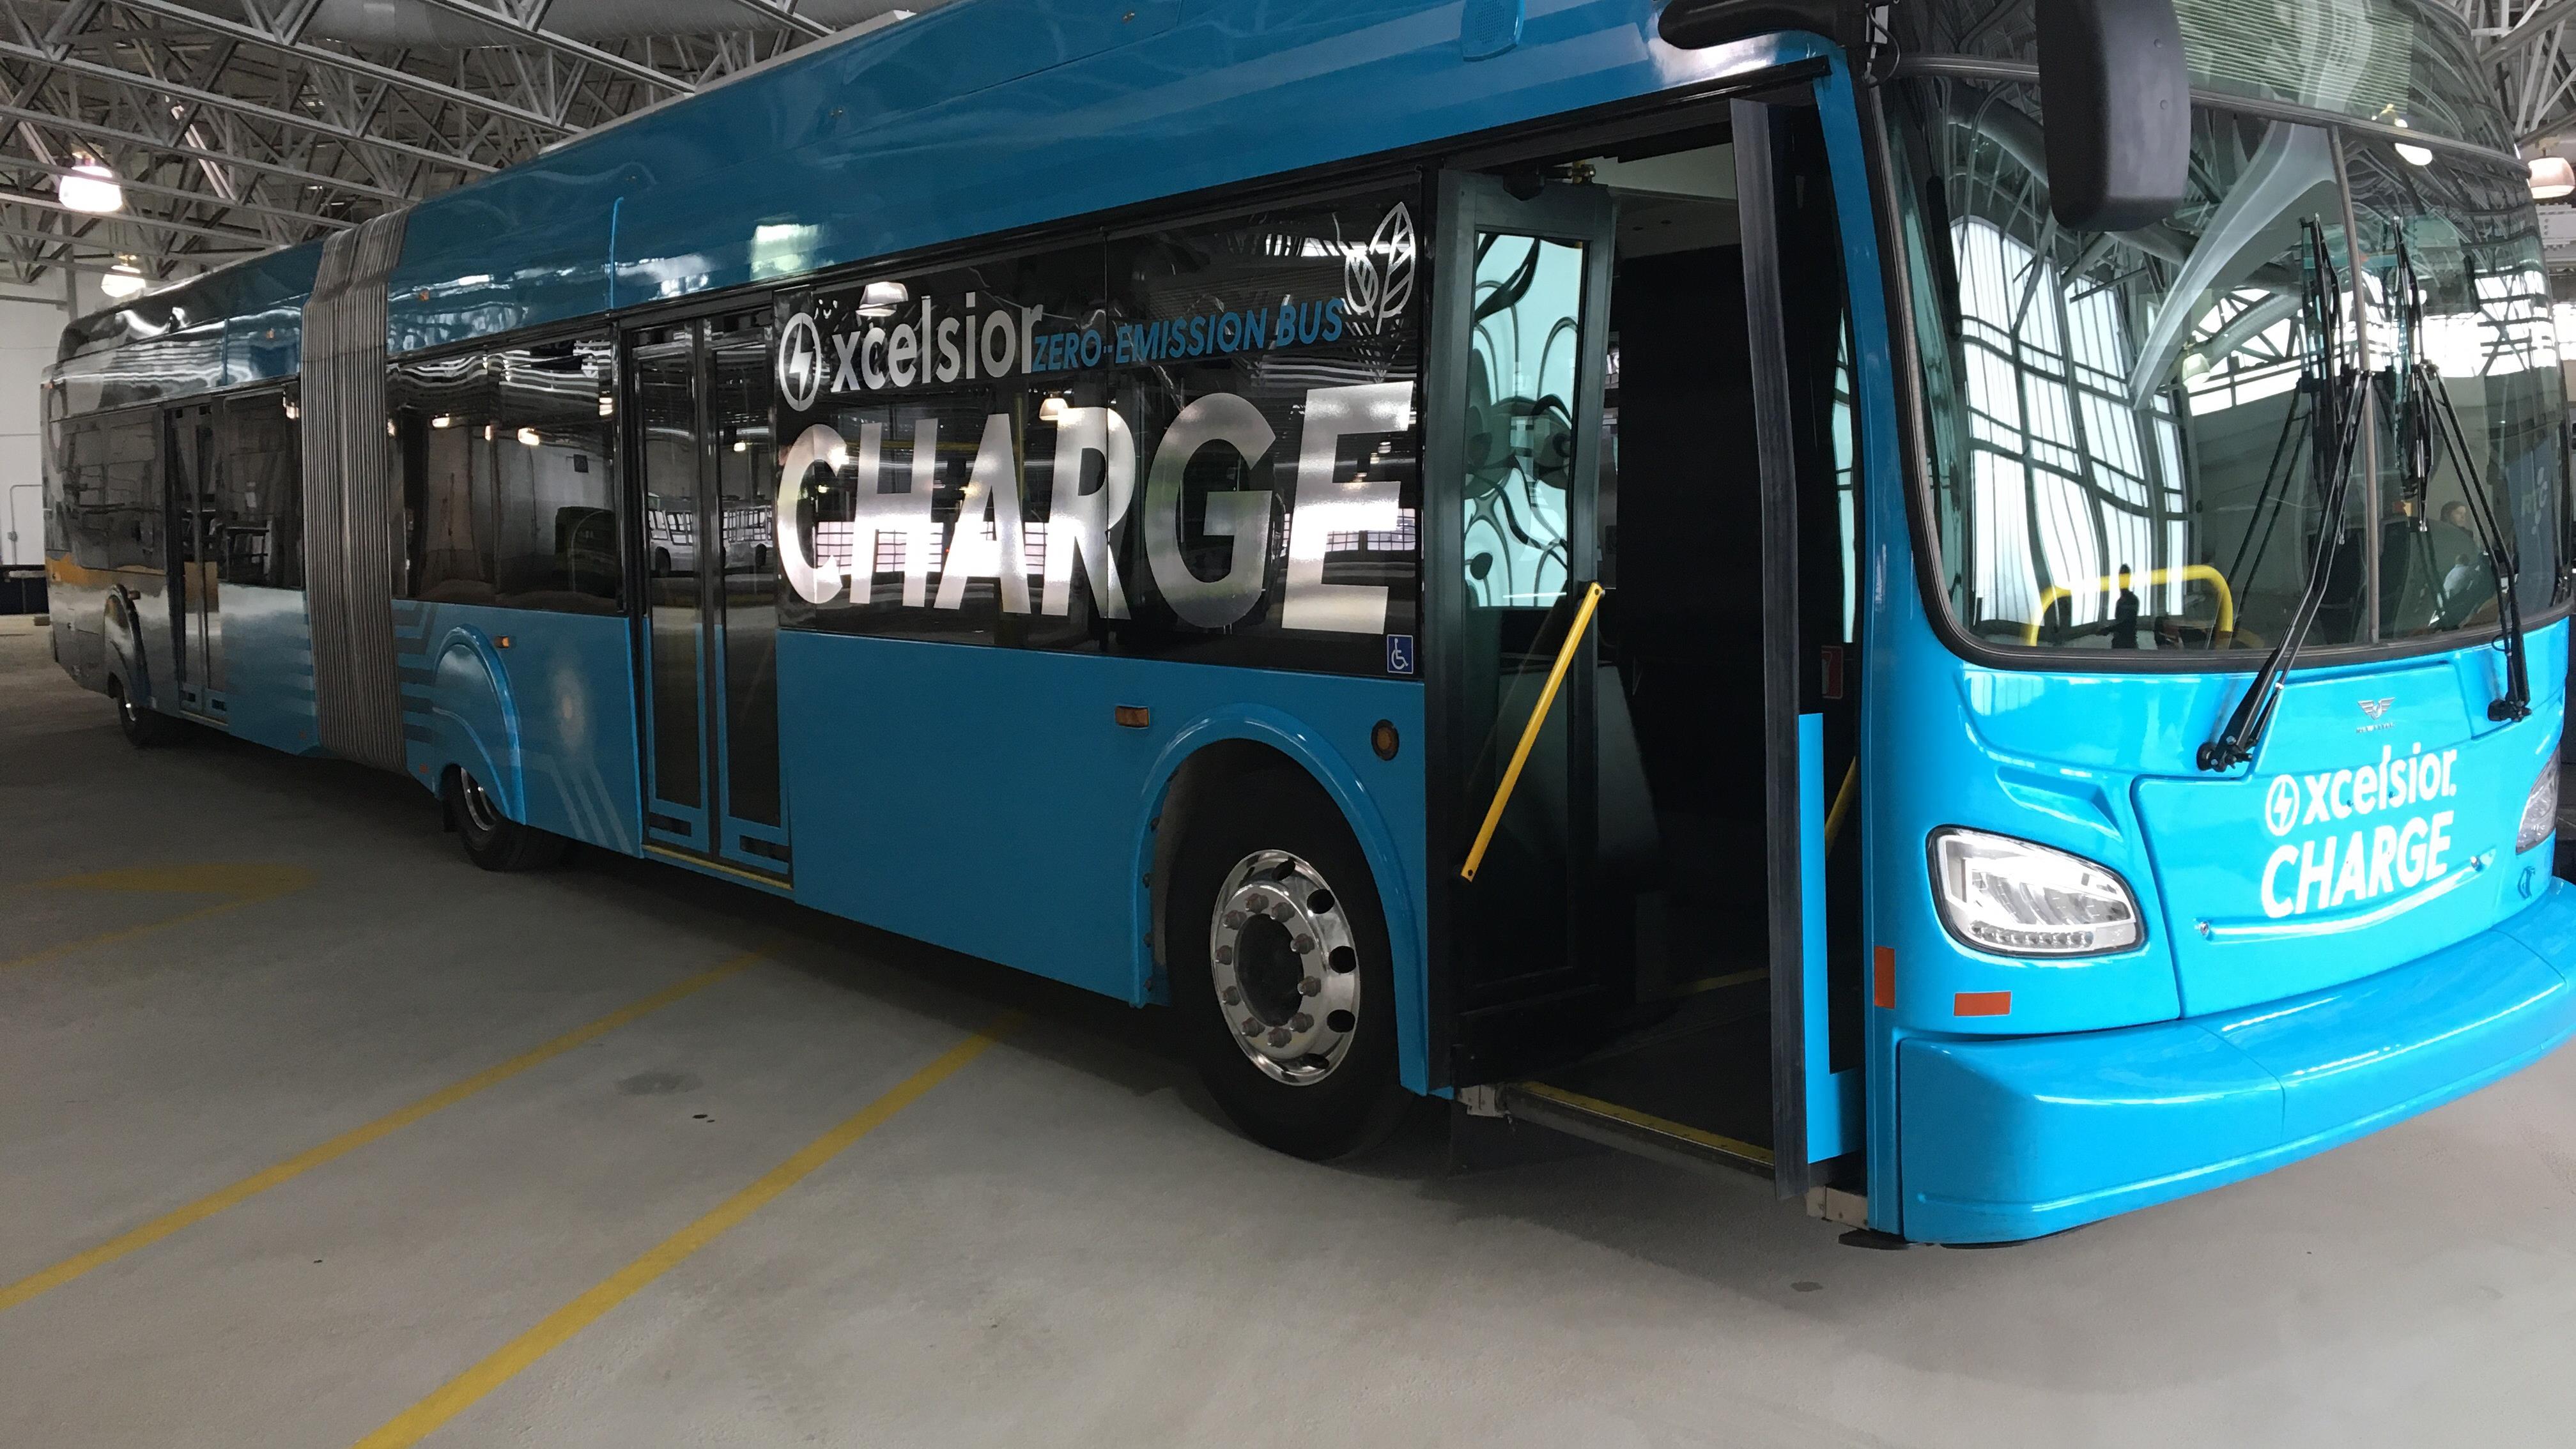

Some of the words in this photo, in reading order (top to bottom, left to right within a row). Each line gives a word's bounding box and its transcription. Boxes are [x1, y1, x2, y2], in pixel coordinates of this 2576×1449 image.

[1276, 296, 1343, 347] BUS
[778, 381, 1414, 634] CHARGE
[2260, 810, 2454, 918] CHARGE
